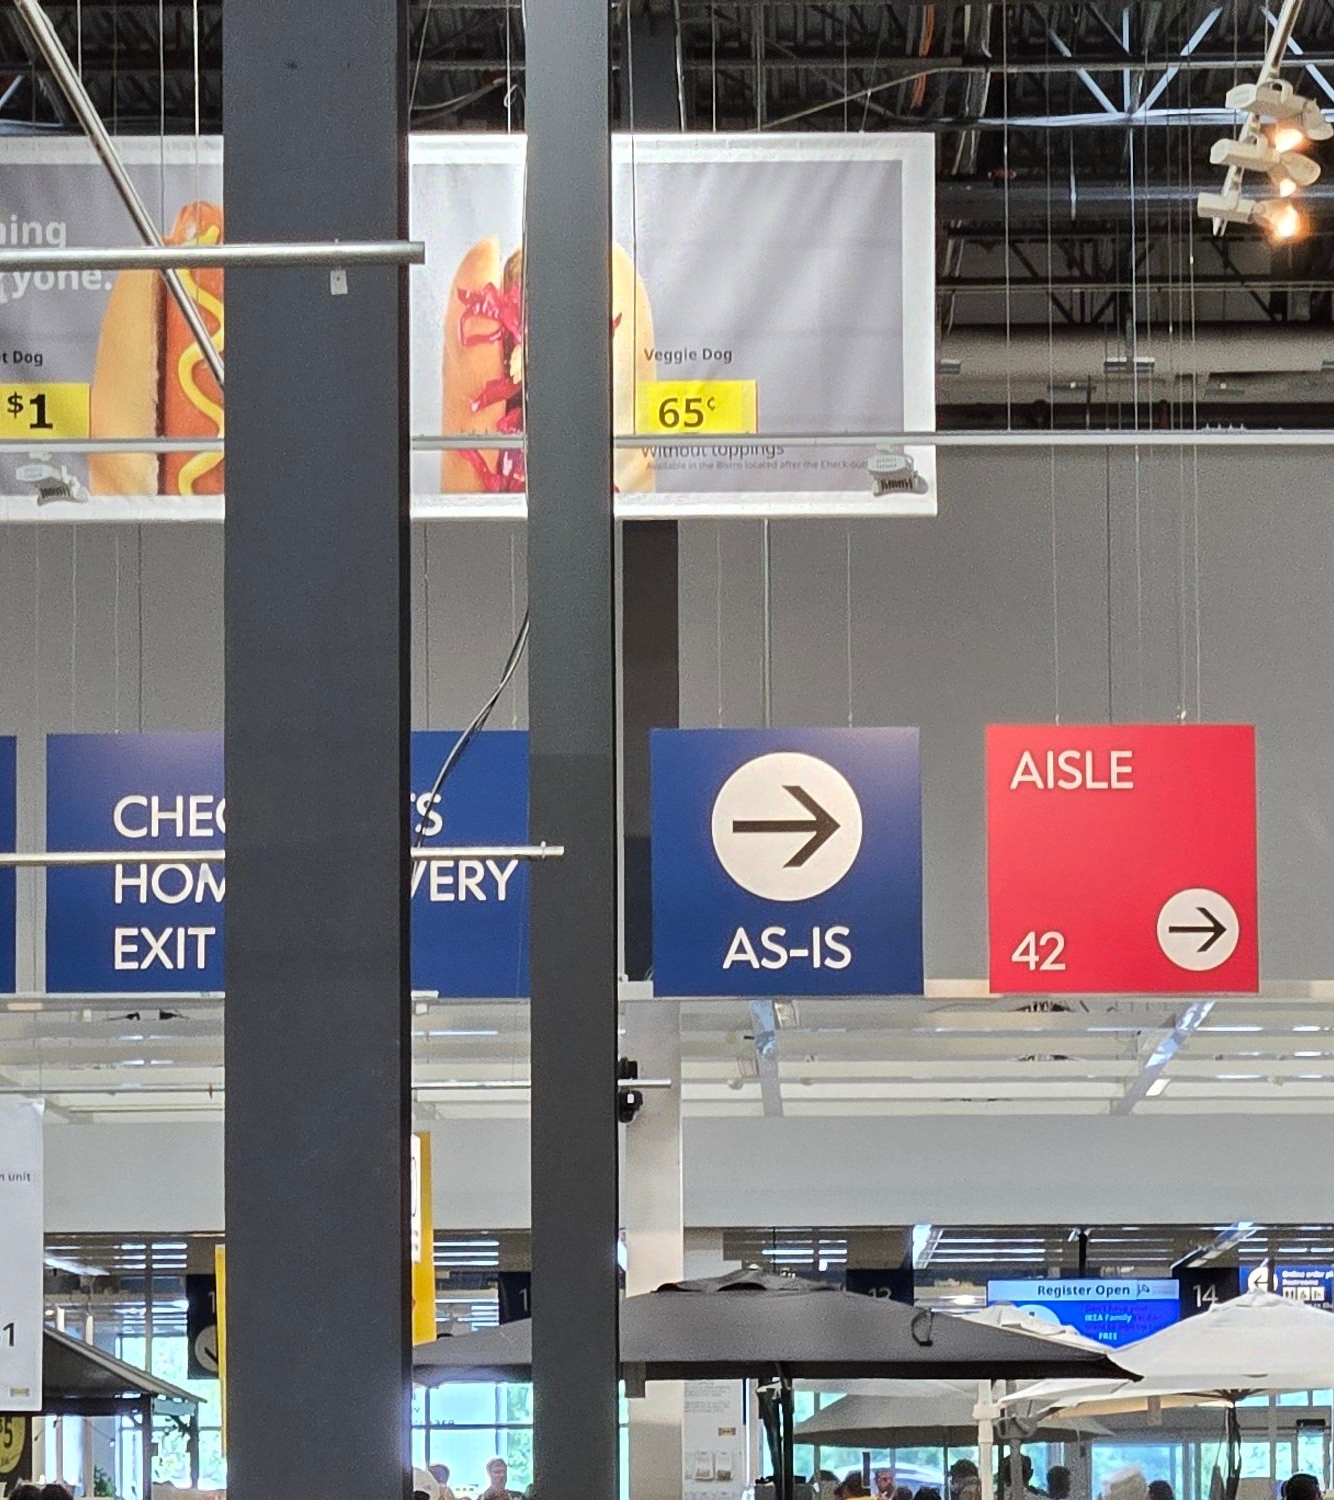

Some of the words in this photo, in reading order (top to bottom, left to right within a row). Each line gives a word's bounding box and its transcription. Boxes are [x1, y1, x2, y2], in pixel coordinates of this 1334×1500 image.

[13, 351, 44, 366] Dog
[644, 348, 697, 364] Veggie
[702, 348, 733, 364] Dog
[7, 391, 54, 429] $1
[658, 396, 716, 429] 65¢
[1009, 750, 1134, 790] AISLE
[114, 926, 217, 970] EXIT
[722, 925, 853, 970] AS-IS
[1010, 930, 1067, 972] 42
[8, 1171, 31, 1182] unit
[1037, 1284, 1092, 1298] Register
[1095, 1284, 1130, 1298] Open
[1193, 1284, 1219, 1308] 14
